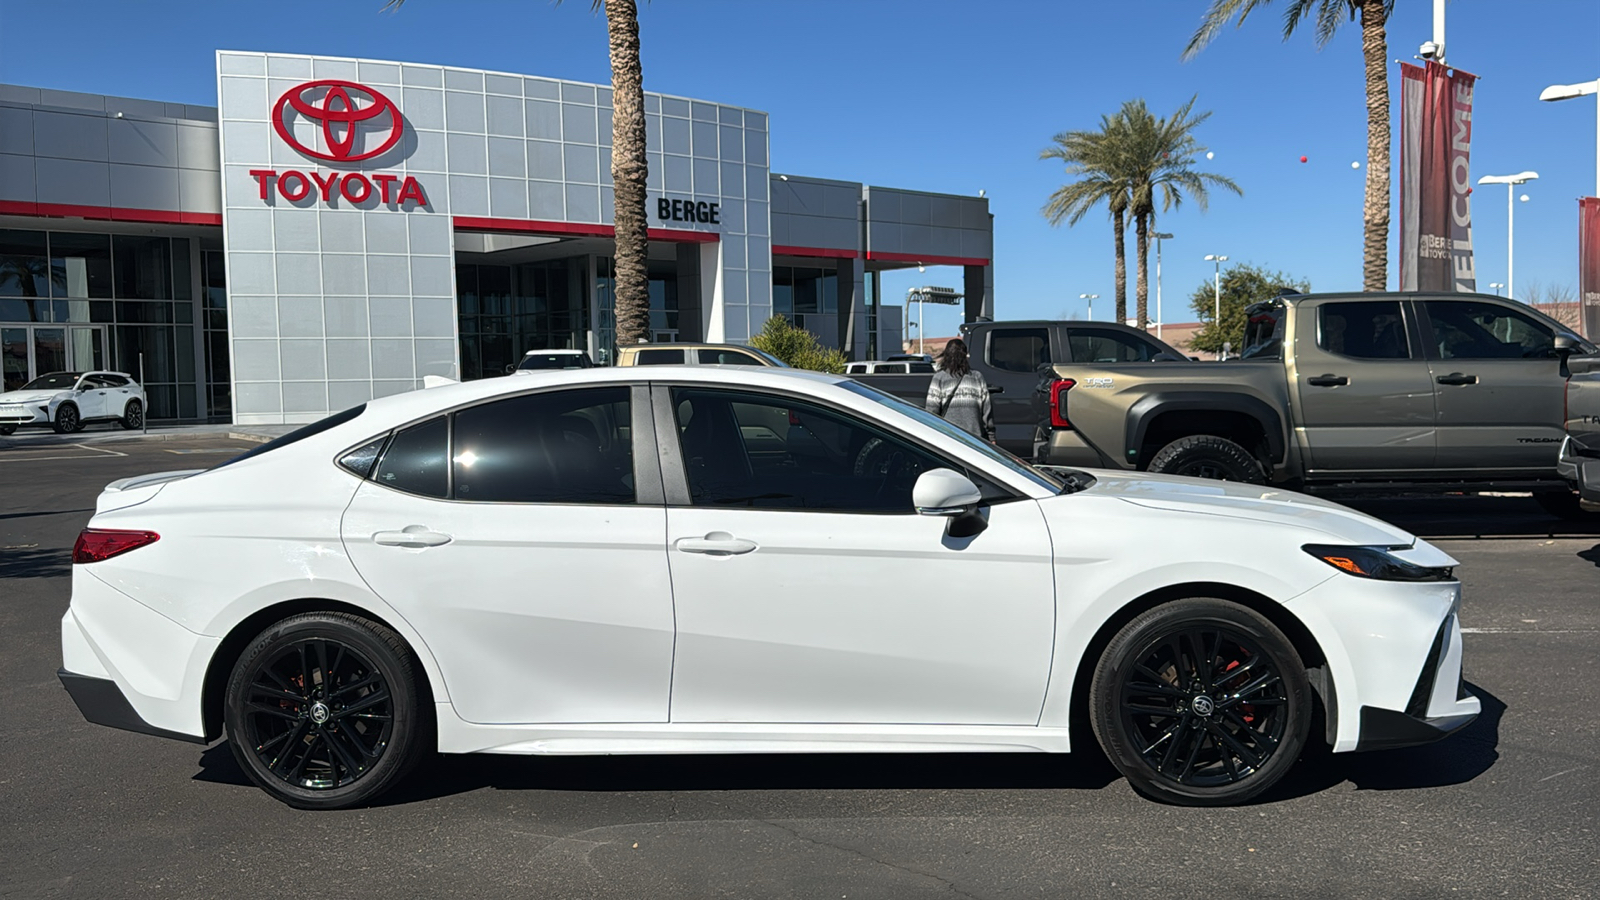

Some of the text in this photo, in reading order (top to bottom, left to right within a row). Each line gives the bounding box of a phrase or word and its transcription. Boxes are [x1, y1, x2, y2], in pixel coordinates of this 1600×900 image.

[249, 169, 427, 206] TOYOTA
[1451, 79, 1476, 293] ELCOME
[658, 198, 720, 224] BERGE
